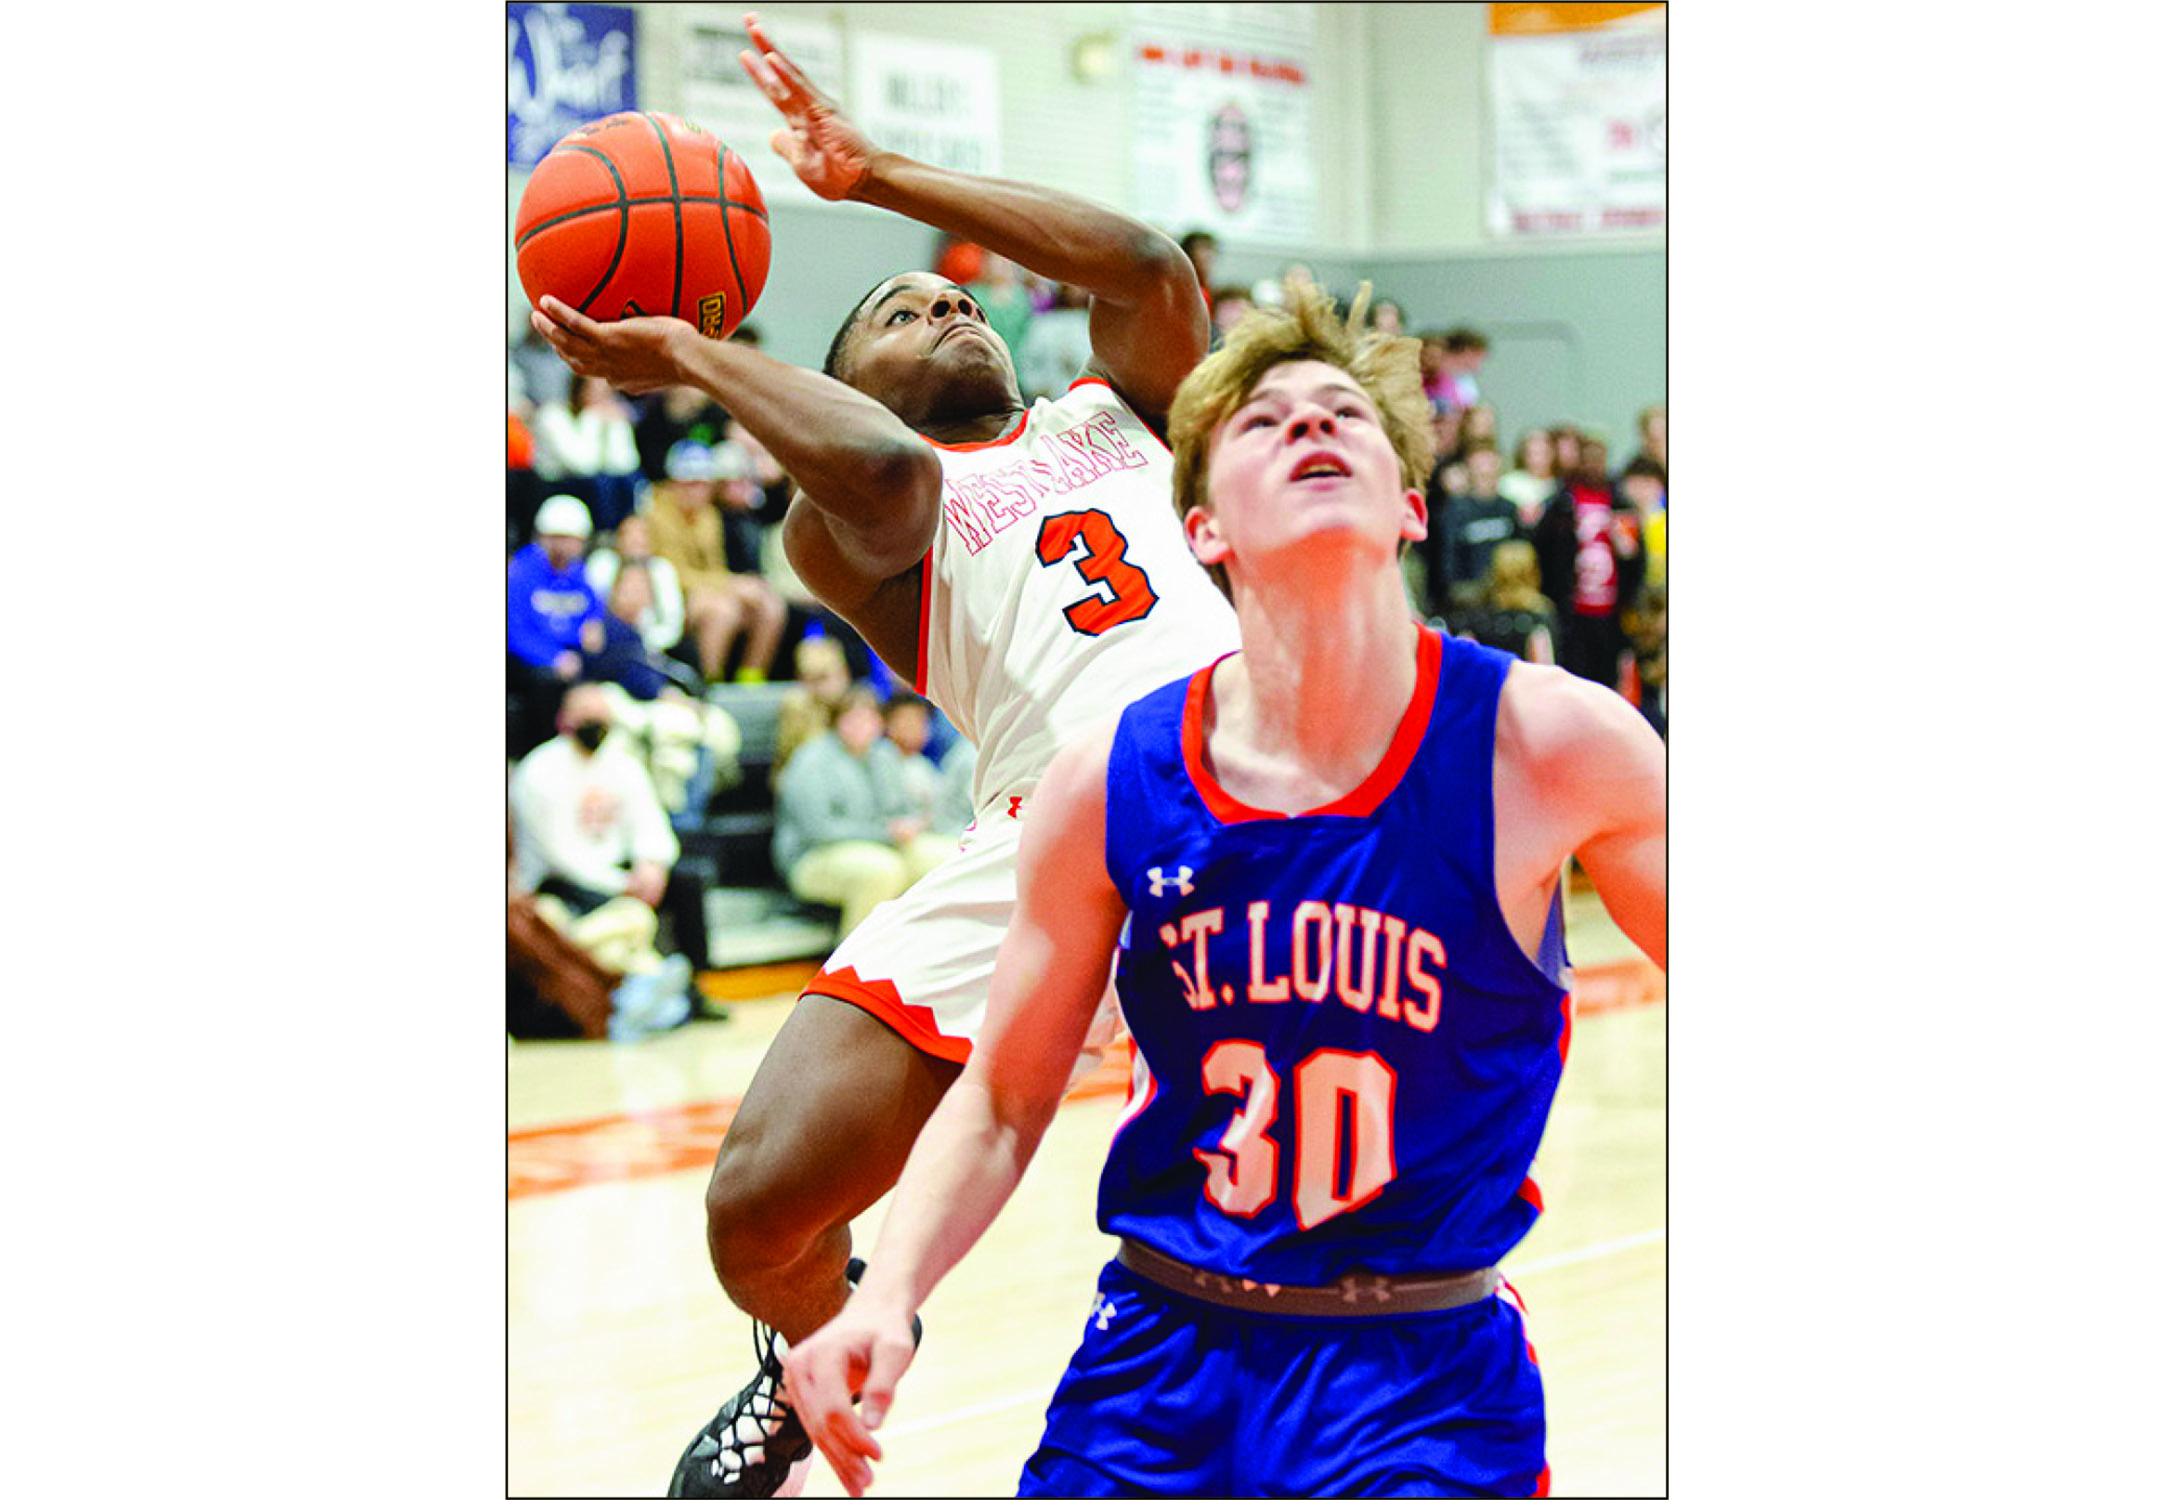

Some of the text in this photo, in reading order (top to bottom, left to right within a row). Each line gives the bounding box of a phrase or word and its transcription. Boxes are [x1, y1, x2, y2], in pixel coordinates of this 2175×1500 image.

[1035, 507, 1160, 637] 3
[1246, 899, 1448, 1034] LOUIS
[1192, 1038, 1398, 1232] 30
